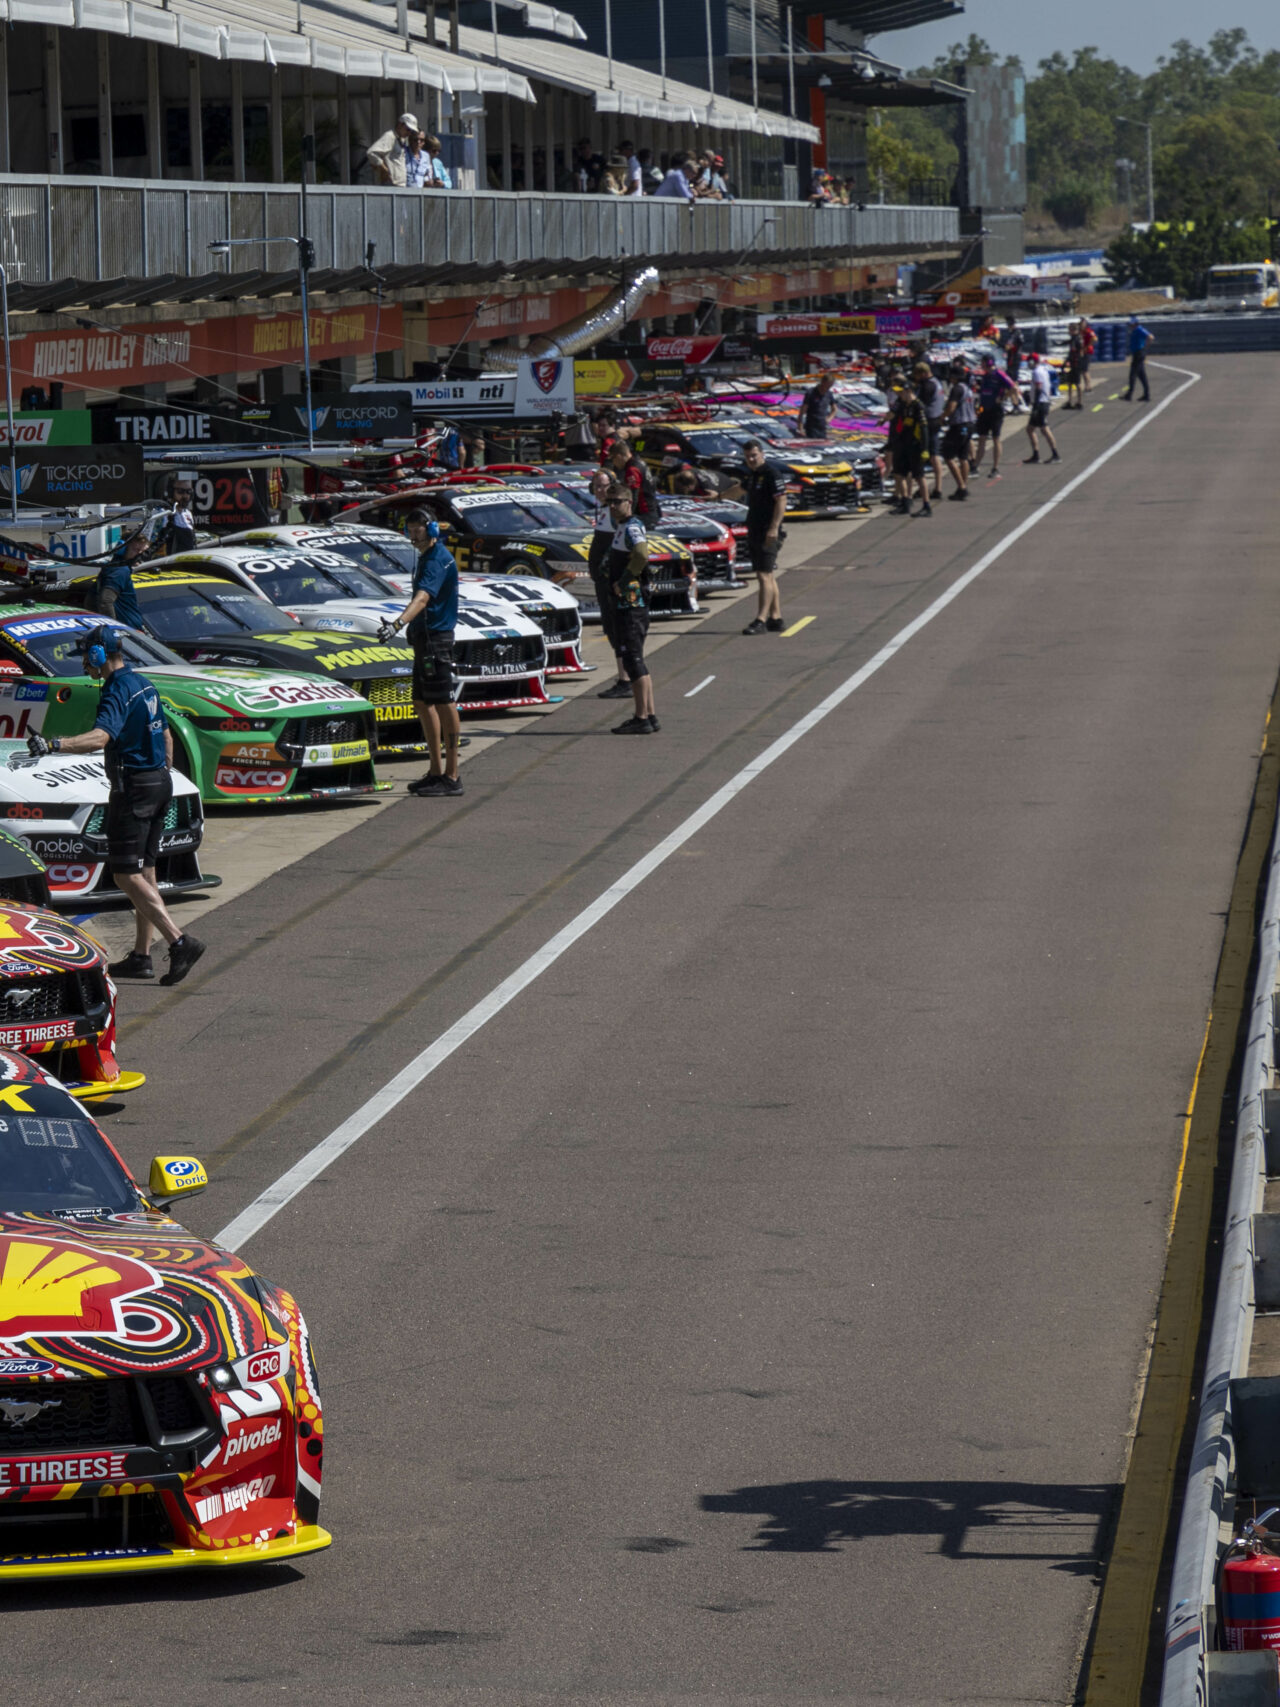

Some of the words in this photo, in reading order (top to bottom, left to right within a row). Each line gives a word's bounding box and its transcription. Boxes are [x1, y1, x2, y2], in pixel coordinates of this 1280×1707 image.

[253, 321, 288, 354] HIDDEN
[330, 313, 366, 343] DARWIN
[784, 323, 818, 332] HINO
[33, 338, 84, 378] HIDDEN
[86, 334, 137, 372] VALLEY
[142, 330, 191, 367] DARWIN
[416, 387, 451, 400] Mobil
[479, 384, 505, 399] nti
[115, 415, 211, 441] TRADIE
[336, 420, 373, 429] RACING
[47, 480, 93, 492] RACING
[195, 478, 255, 512] 926
[299, 535, 362, 548] ISUZU
[245, 554, 359, 573] OPTUS
[316, 618, 353, 628] move
[315, 646, 415, 671] MONEYM
[480, 665, 503, 677] PALM
[503, 663, 527, 677] TRANS
[26, 687, 46, 698] betr
[375, 705, 419, 722] RADIE.
[219, 718, 251, 731] dba
[237, 746, 271, 759] ACT
[333, 744, 367, 758] ultimate
[216, 768, 287, 786] RYCO
[7, 802, 44, 819] dba
[35, 838, 84, 854] noble
[39, 853, 78, 861] LOGISTICS
[49, 864, 90, 883] CO
[1, 962, 35, 973] Ford
[27, 1022, 71, 1043] THREES
[175, 1174, 207, 1189] Doric
[249, 1353, 281, 1380] CRC
[223, 1418, 282, 1465] pivotel.
[16, 1457, 109, 1483] THREES
[223, 1474, 276, 1512] Repco
